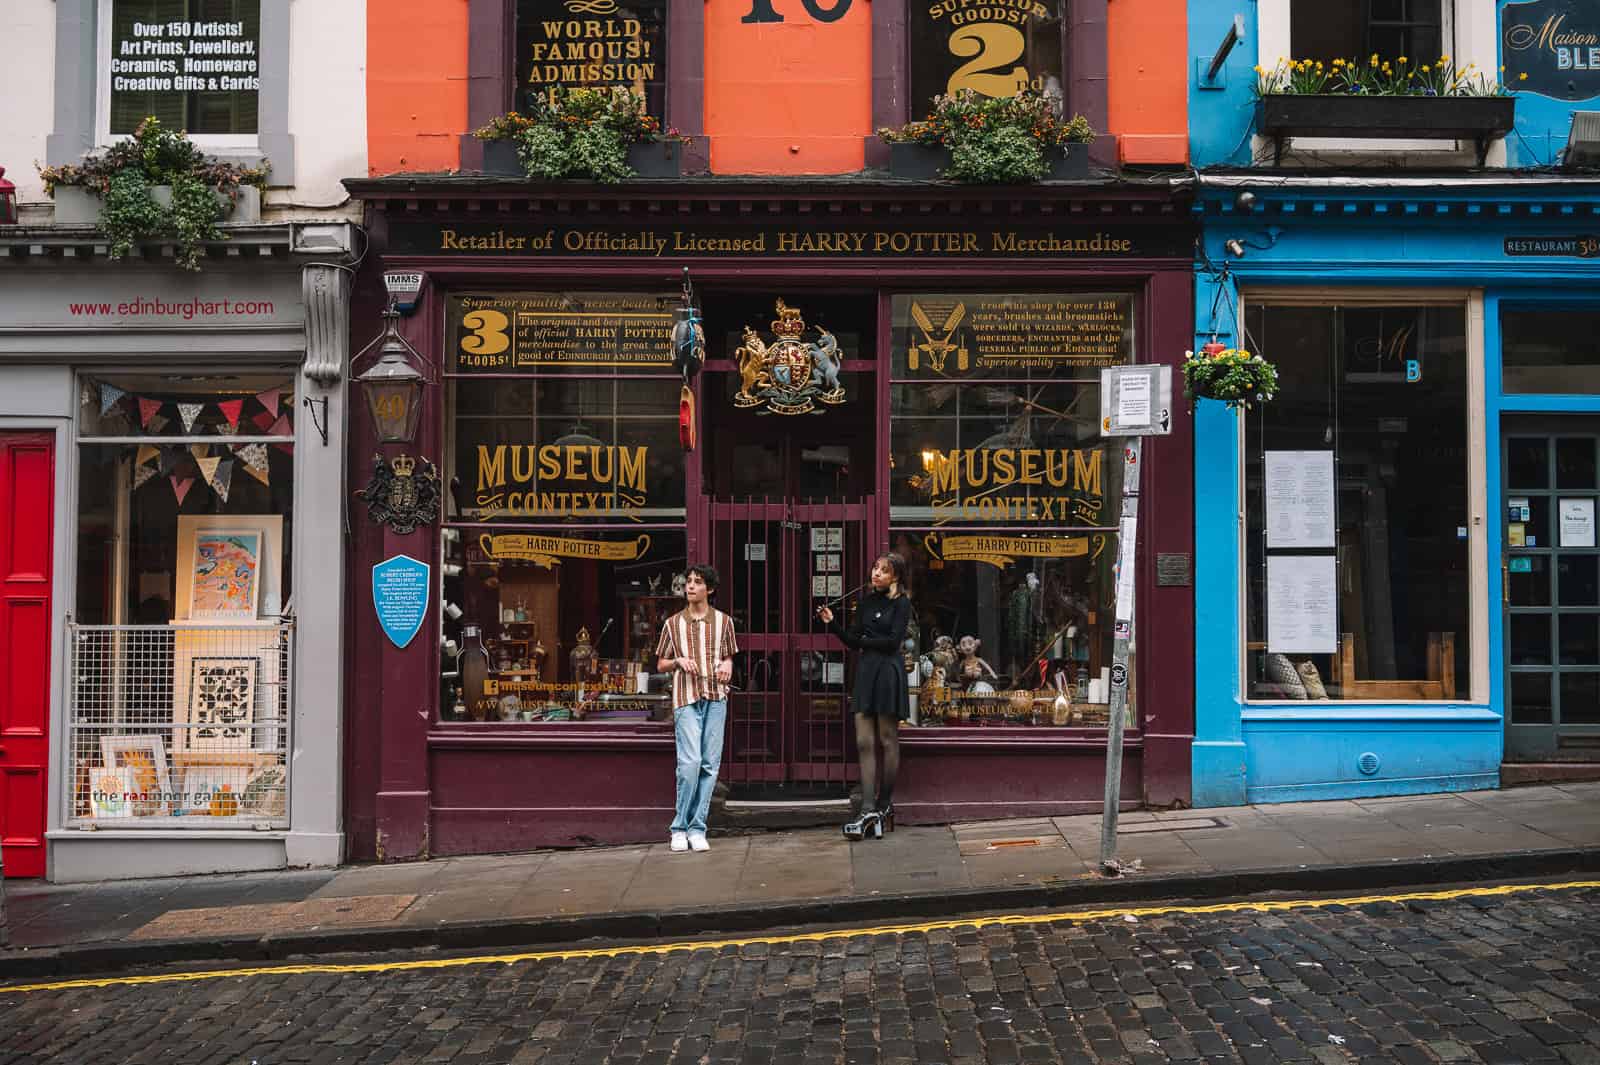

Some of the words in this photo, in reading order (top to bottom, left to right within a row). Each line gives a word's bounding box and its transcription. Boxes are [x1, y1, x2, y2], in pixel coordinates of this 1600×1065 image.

[951, 8, 1028, 25] GOODS!
[133, 22, 164, 37] Over
[167, 22, 191, 37] 150
[193, 22, 243, 37] Artists!
[543, 19, 641, 39] WORLD
[1505, 15, 1598, 53] Maison
[120, 41, 141, 55] Art
[143, 41, 186, 57] Prints,
[188, 41, 256, 57] Jewellery,
[532, 41, 651, 61] FAMOUS!
[111, 59, 179, 74] Ceramics,
[184, 59, 257, 73] Homeware
[528, 63, 656, 83] ADMISSION
[114, 76, 171, 91] Creative
[174, 76, 206, 91] Gifts
[208, 77, 218, 91] &
[220, 76, 260, 91] Cards
[440, 230, 527, 250] Retailer
[532, 230, 555, 250] of
[564, 230, 667, 257] Officially
[673, 231, 766, 251] Licensed
[775, 231, 867, 252] HARRY
[872, 231, 979, 252] POTTER
[992, 231, 1132, 252] Merchandise
[1507, 241, 1578, 251] RESTAURANT
[387, 275, 420, 284] IMMS
[69, 297, 274, 319] www.edinburghart.com
[519, 316, 540, 326] The
[541, 316, 580, 329] original
[461, 309, 510, 355] 3
[518, 327, 529, 337] of
[534, 327, 569, 339] official
[575, 327, 617, 338] HARRY
[623, 328, 673, 338] POTTER
[585, 341, 596, 350] to
[601, 341, 617, 350] the
[623, 341, 649, 352] great
[655, 341, 672, 350] and
[460, 354, 509, 367] FLOORS!
[518, 350, 542, 361] good
[544, 350, 556, 360] of
[1407, 359, 1422, 383] B
[476, 444, 649, 493] MUSEUM
[931, 448, 1103, 496] MUSEUM
[507, 492, 617, 517] CONTEXT
[962, 496, 1070, 521] CONTEXT
[527, 537, 562, 553] HARRY
[563, 540, 601, 556] POTTER
[976, 538, 1009, 552] HARRY
[1013, 540, 1052, 553] POTTER
[93, 789, 118, 801] the
[123, 789, 148, 801] red
